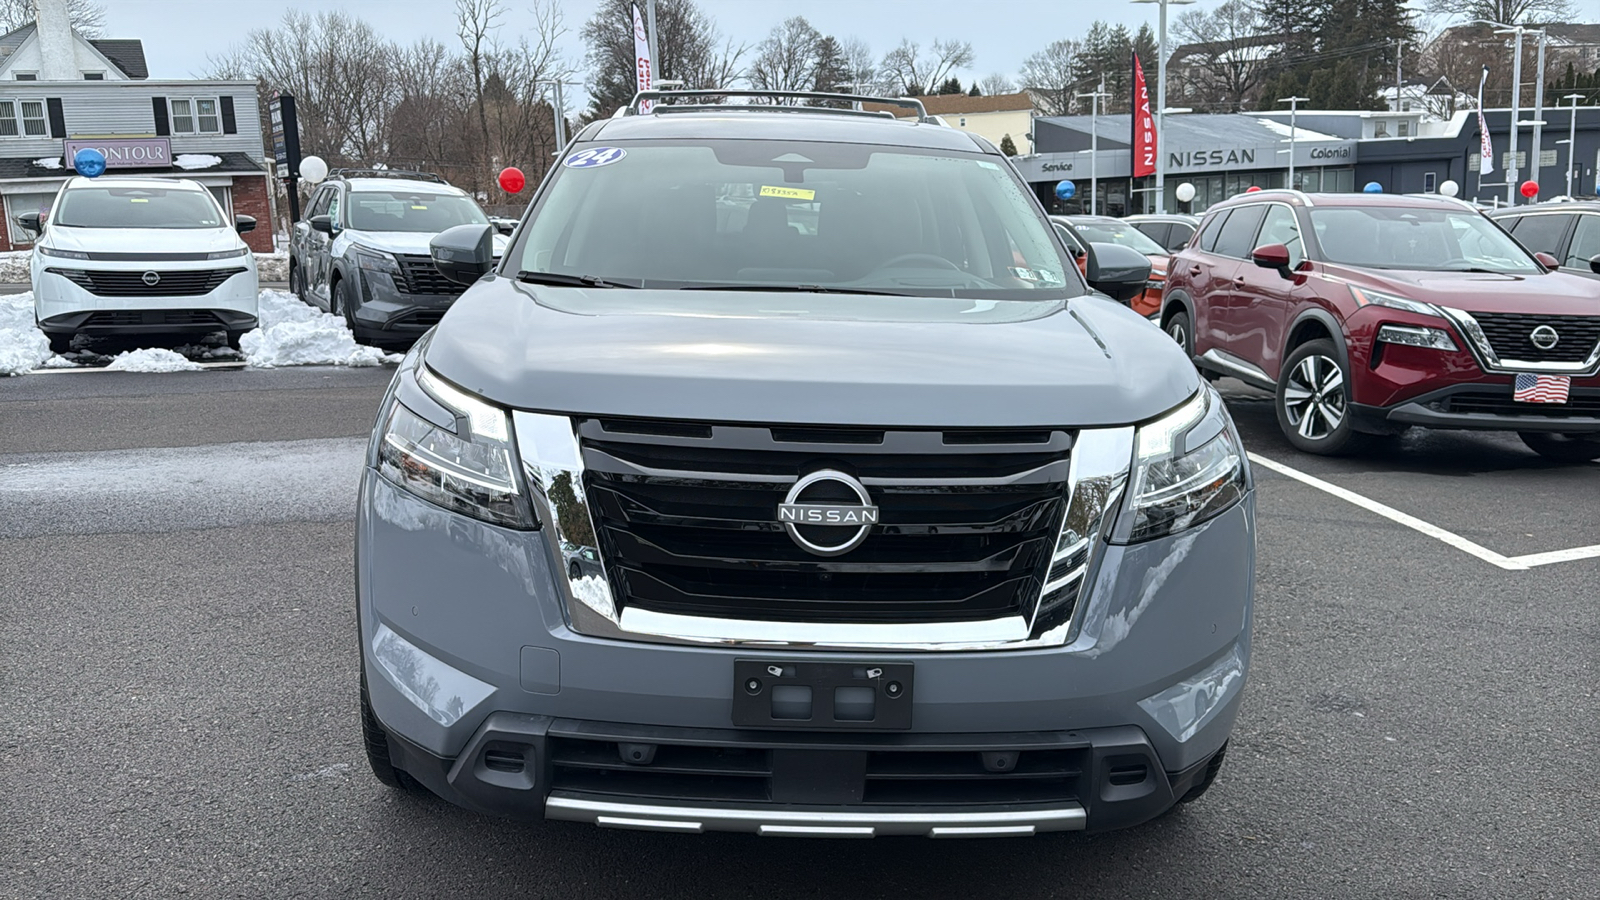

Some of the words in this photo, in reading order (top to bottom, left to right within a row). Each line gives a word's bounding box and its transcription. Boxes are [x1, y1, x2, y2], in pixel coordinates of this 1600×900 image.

[1141, 87, 1153, 165] NISSAN
[569, 148, 620, 165] 24
[1169, 149, 1255, 168] NISSAN
[1310, 147, 1351, 159] Colonial
[1041, 162, 1073, 172] Service
[781, 507, 876, 522] NISSAN
